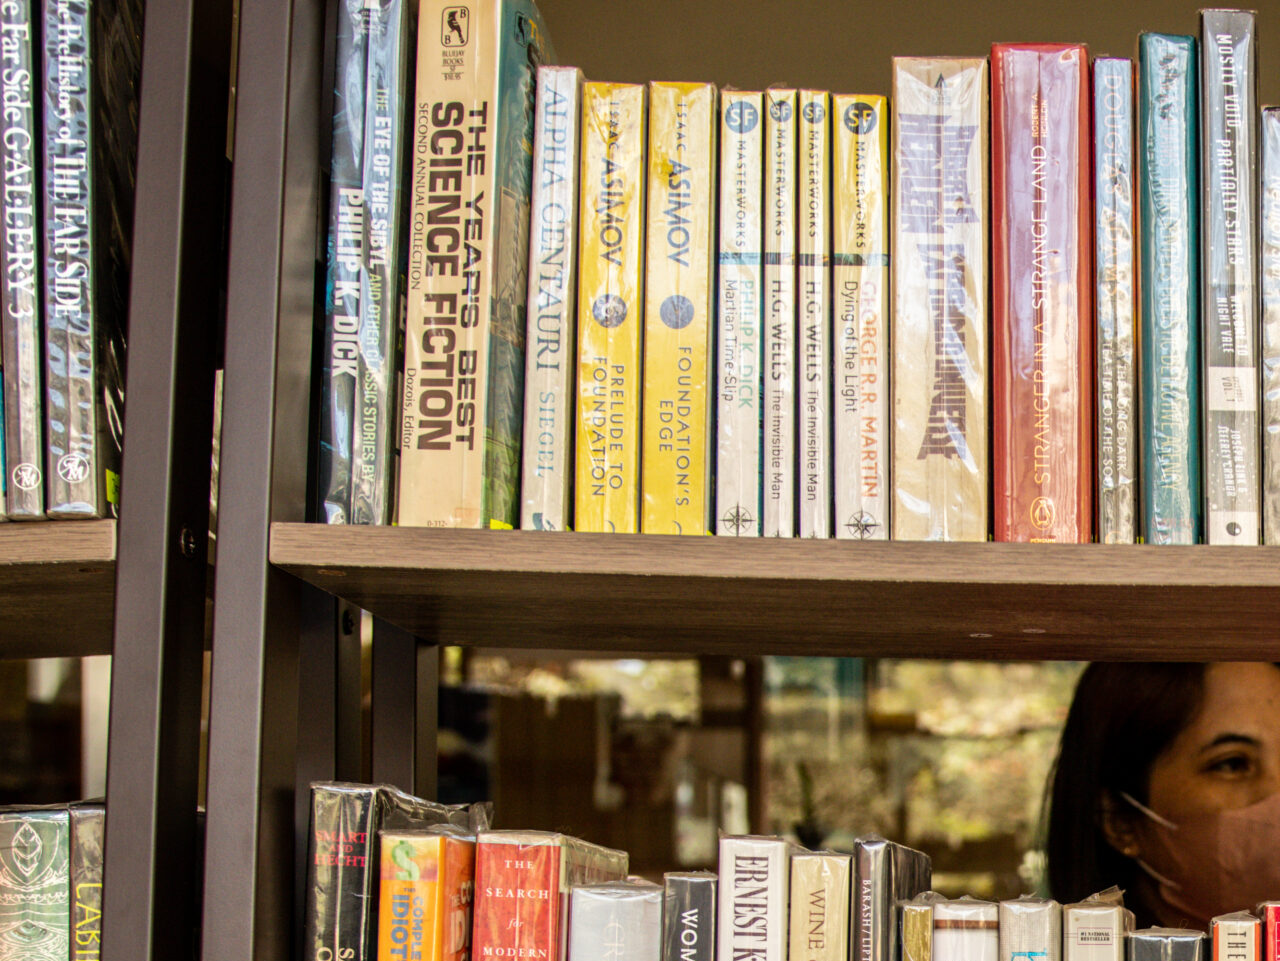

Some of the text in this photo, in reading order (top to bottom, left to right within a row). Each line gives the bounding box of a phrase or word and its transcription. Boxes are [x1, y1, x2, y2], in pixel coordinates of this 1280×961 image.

[1, 24, 31, 122] Far Side
[664, 159, 692, 267] ASIMOV
[736, 140, 746, 247] MASTERWORKS
[1031, 144, 1047, 203] LAND
[54, 153, 86, 318] THE FAR SIDE
[332, 188, 363, 378] PHILIP DICK
[417, 101, 465, 450] SCIENCE FICTION
[455, 101, 487, 450] THE YEAR'S BEST
[536, 85, 567, 478] ALPHA CENTAURI SIEGEL
[725, 280, 739, 332] Martian
[592, 357, 607, 497] FOUNDATION
[609, 365, 624, 489] PRELUDE TO
[659, 400, 673, 452] EDGE
[676, 347, 692, 506] FOUNDATION'S
[861, 416, 878, 498] MARTIN
[485, 887, 548, 899] SEARCH
[504, 860, 535, 870] THE
[732, 854, 769, 942] ERNEST
[482, 946, 548, 958] MODERN
[807, 888, 826, 950] WINE
[1227, 932, 1247, 960] THE
